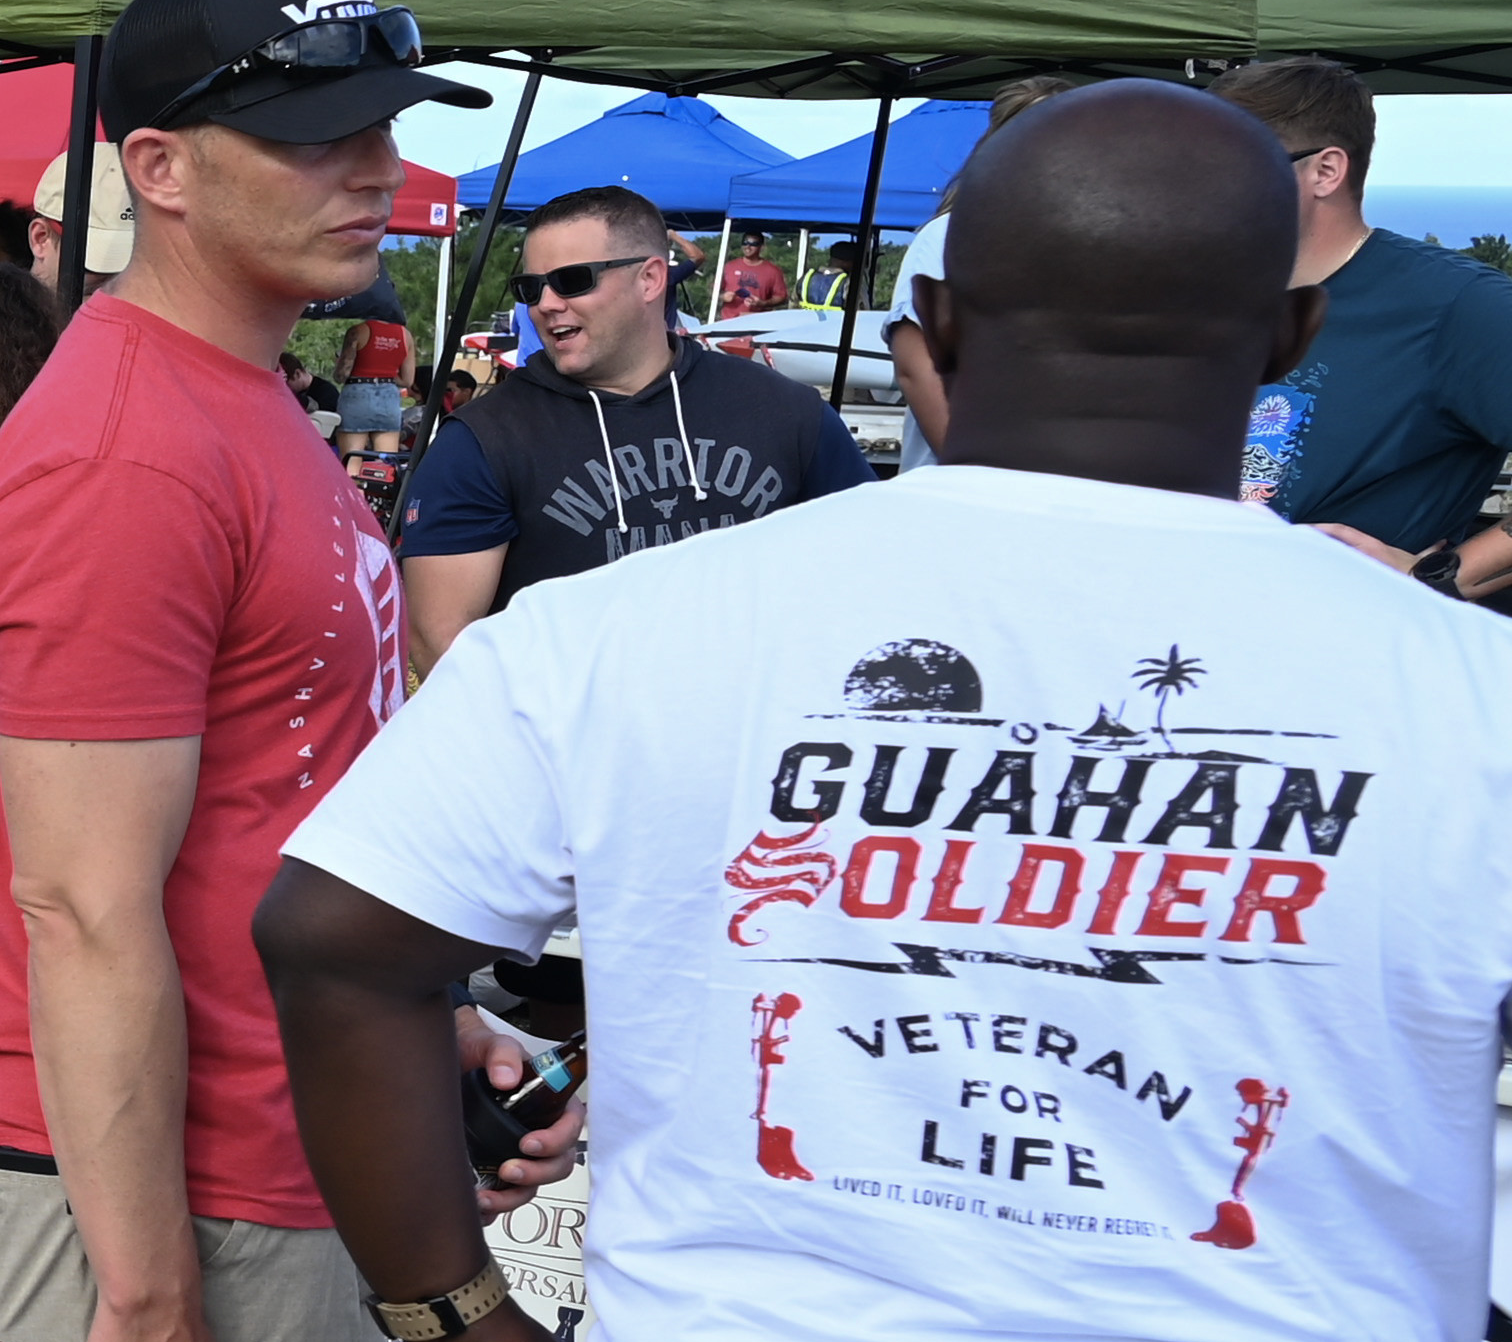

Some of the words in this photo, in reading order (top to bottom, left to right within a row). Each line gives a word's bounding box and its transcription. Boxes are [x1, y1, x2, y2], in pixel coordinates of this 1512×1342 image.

[541, 437, 783, 537] WARRIOR
[837, 1011, 1193, 1122] VETERAN
[960, 1078, 1063, 1123] FOR
[920, 1119, 1106, 1190] LIFE
[833, 1175, 882, 1198] LIVED
[996, 1205, 1035, 1226] WILL
[1042, 1211, 1098, 1234] NEVER
